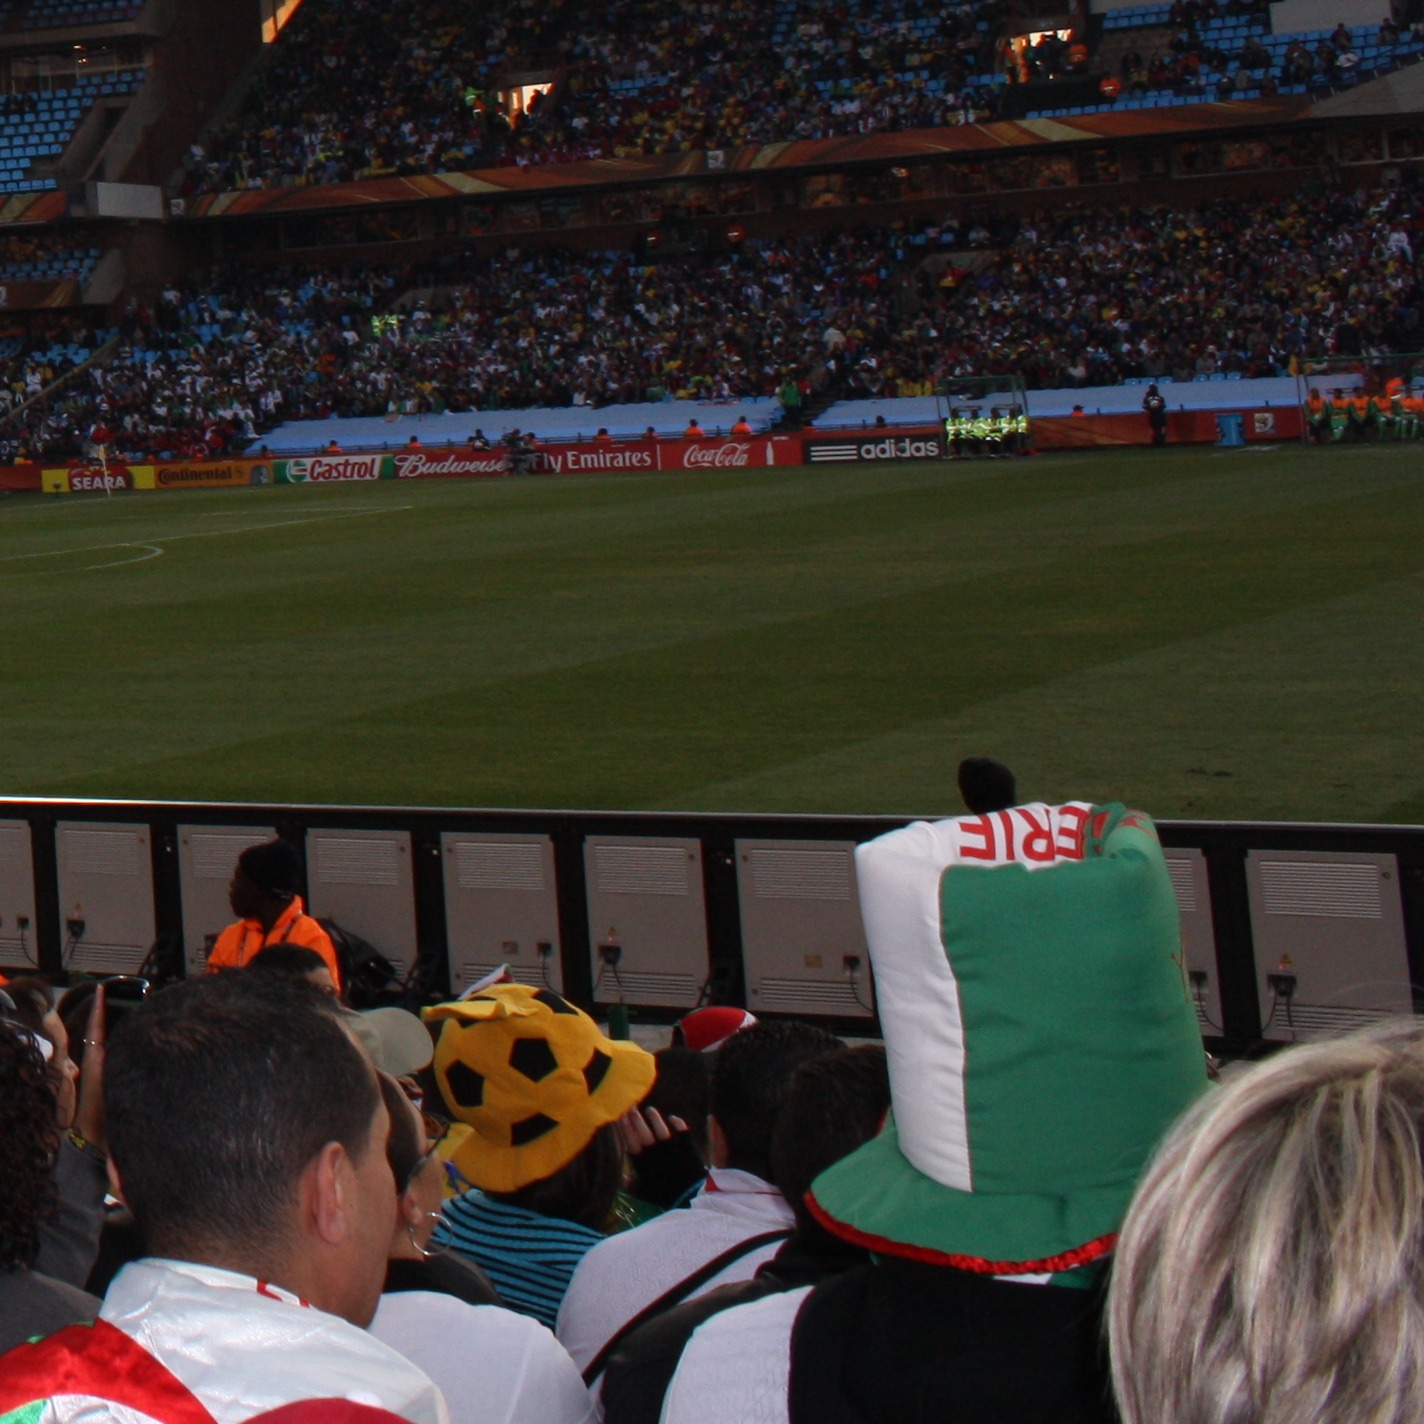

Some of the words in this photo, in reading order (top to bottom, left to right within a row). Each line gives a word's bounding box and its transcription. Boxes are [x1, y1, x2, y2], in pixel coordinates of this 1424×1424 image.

[861, 438, 939, 459] adidas
[394, 453, 508, 477] Budweise
[566, 449, 652, 469] Emirates
[158, 467, 232, 485] Continental
[310, 457, 377, 482] Castrol
[72, 475, 127, 491] SEARA
